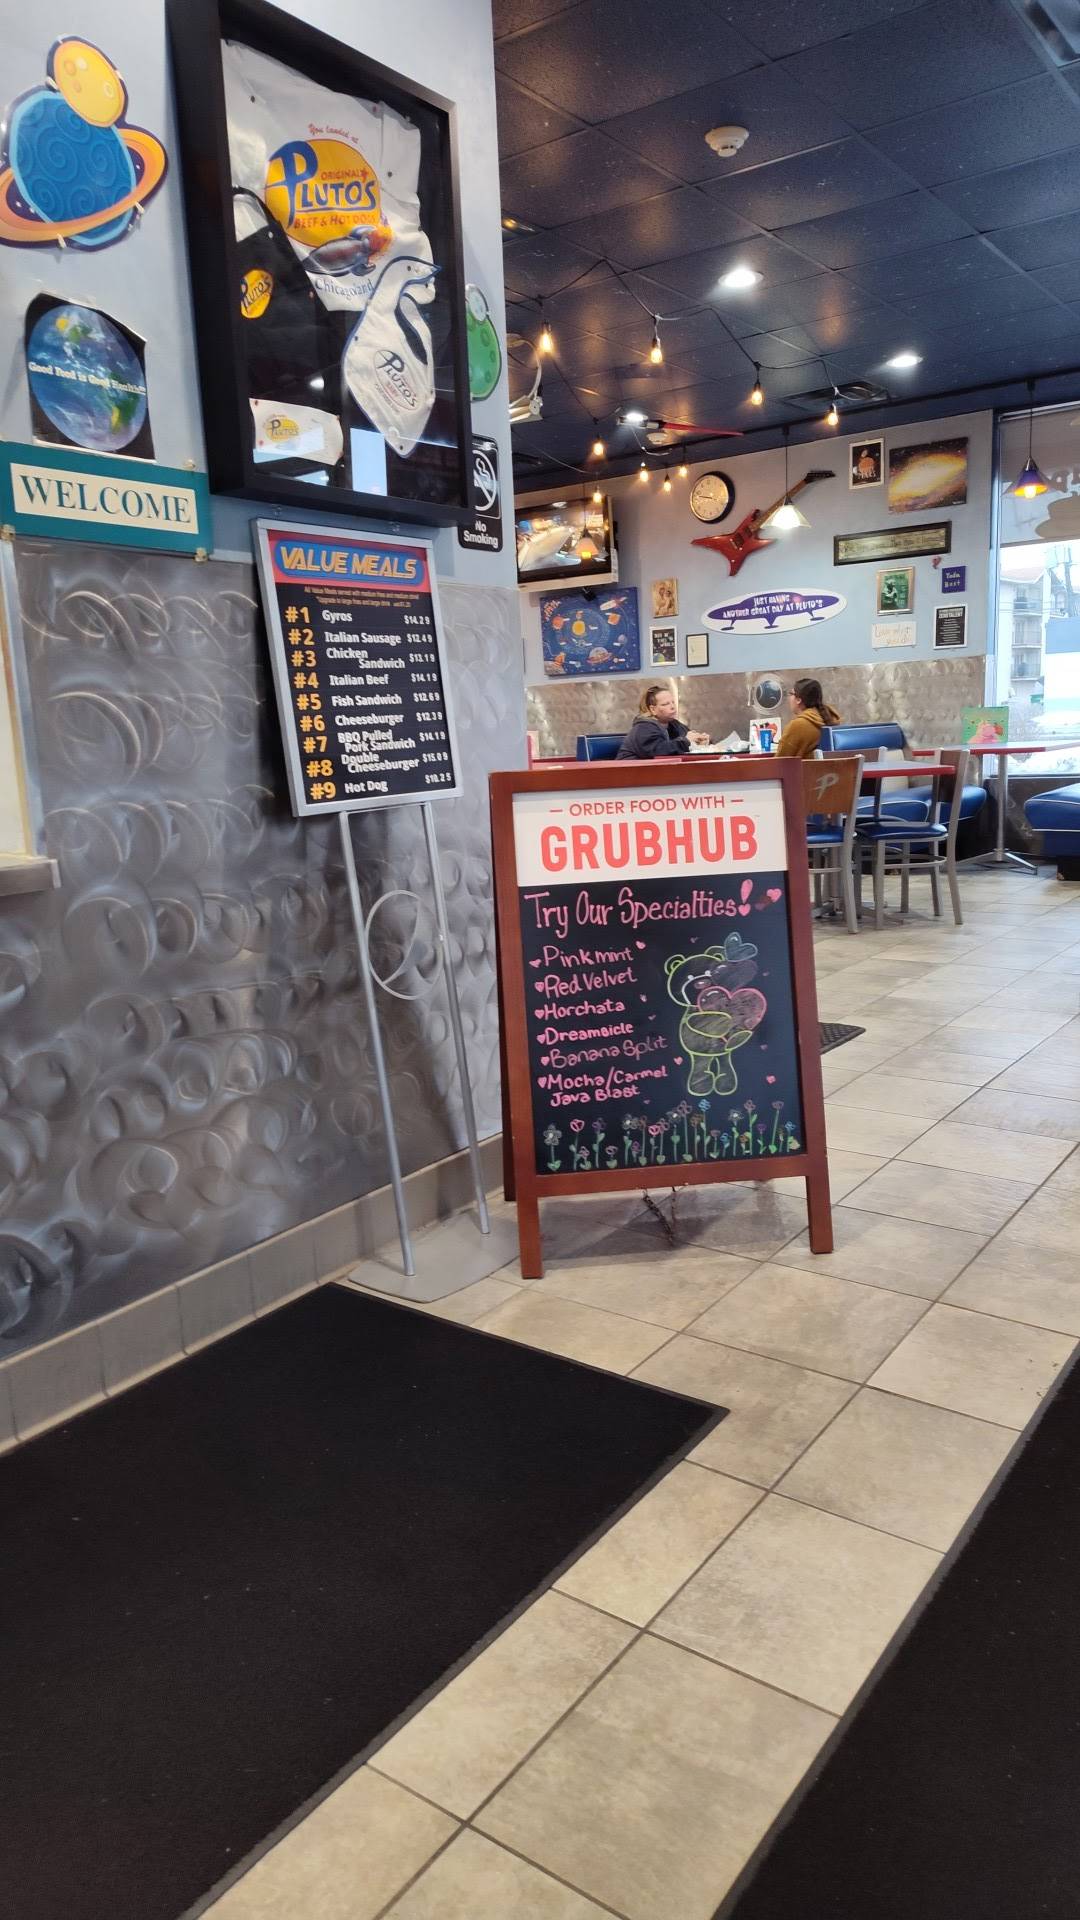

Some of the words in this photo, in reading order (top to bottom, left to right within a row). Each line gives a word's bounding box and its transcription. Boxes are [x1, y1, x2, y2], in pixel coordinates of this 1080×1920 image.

[294, 216, 319, 230] BEEF
[329, 214, 351, 227] HOT
[19, 475, 191, 523] WELCOME
[475, 520, 486, 532] No
[463, 530, 498, 549] Smoking
[280, 546, 349, 574] VALUE
[351, 553, 417, 579] MEALS
[285, 606, 310, 624] #1
[322, 610, 352, 624] Gyros
[288, 628, 315, 645] #2
[324, 631, 360, 643] Italian
[361, 633, 401, 646] Sausage
[291, 650, 317, 668] #3
[326, 648, 369, 659] Chicken
[359, 658, 405, 669] Sandwich
[294, 672, 319, 689] #4
[329, 674, 364, 686] Italian
[366, 674, 389, 686] Beef
[297, 694, 322, 711] #5
[331, 695, 354, 707] Fish
[356, 694, 402, 706] Sandwich
[300, 715, 326, 732] #6
[335, 713, 404, 726] Cheeseburger
[303, 736, 328, 754] #7
[338, 733, 361, 744] BBQ
[362, 729, 393, 743] Pulled
[345, 742, 370, 753] Pork
[370, 738, 416, 752] Sandwich
[306, 760, 334, 778] #8
[347, 758, 420, 774] Cheeseburger
[341, 752, 379, 765] Double
[310, 782, 336, 800] #9
[344, 782, 365, 793] Hot
[367, 780, 389, 793] Dog
[569, 802, 625, 817] ORDER
[630, 798, 677, 813] FOOD
[681, 796, 725, 810] WITH
[540, 815, 758, 872] GRUBHUB
[524, 891, 569, 939] Try
[575, 890, 614, 926] Our
[544, 974, 582, 999] Red
[583, 967, 638, 991] Velvet
[544, 999, 626, 1020] Horchata
[545, 1023, 634, 1045] Dreamsicle
[550, 1045, 621, 1068] Banana
[623, 1035, 668, 1061] Split
[550, 1091, 591, 1107] Java
[595, 1084, 641, 1101] Blast
